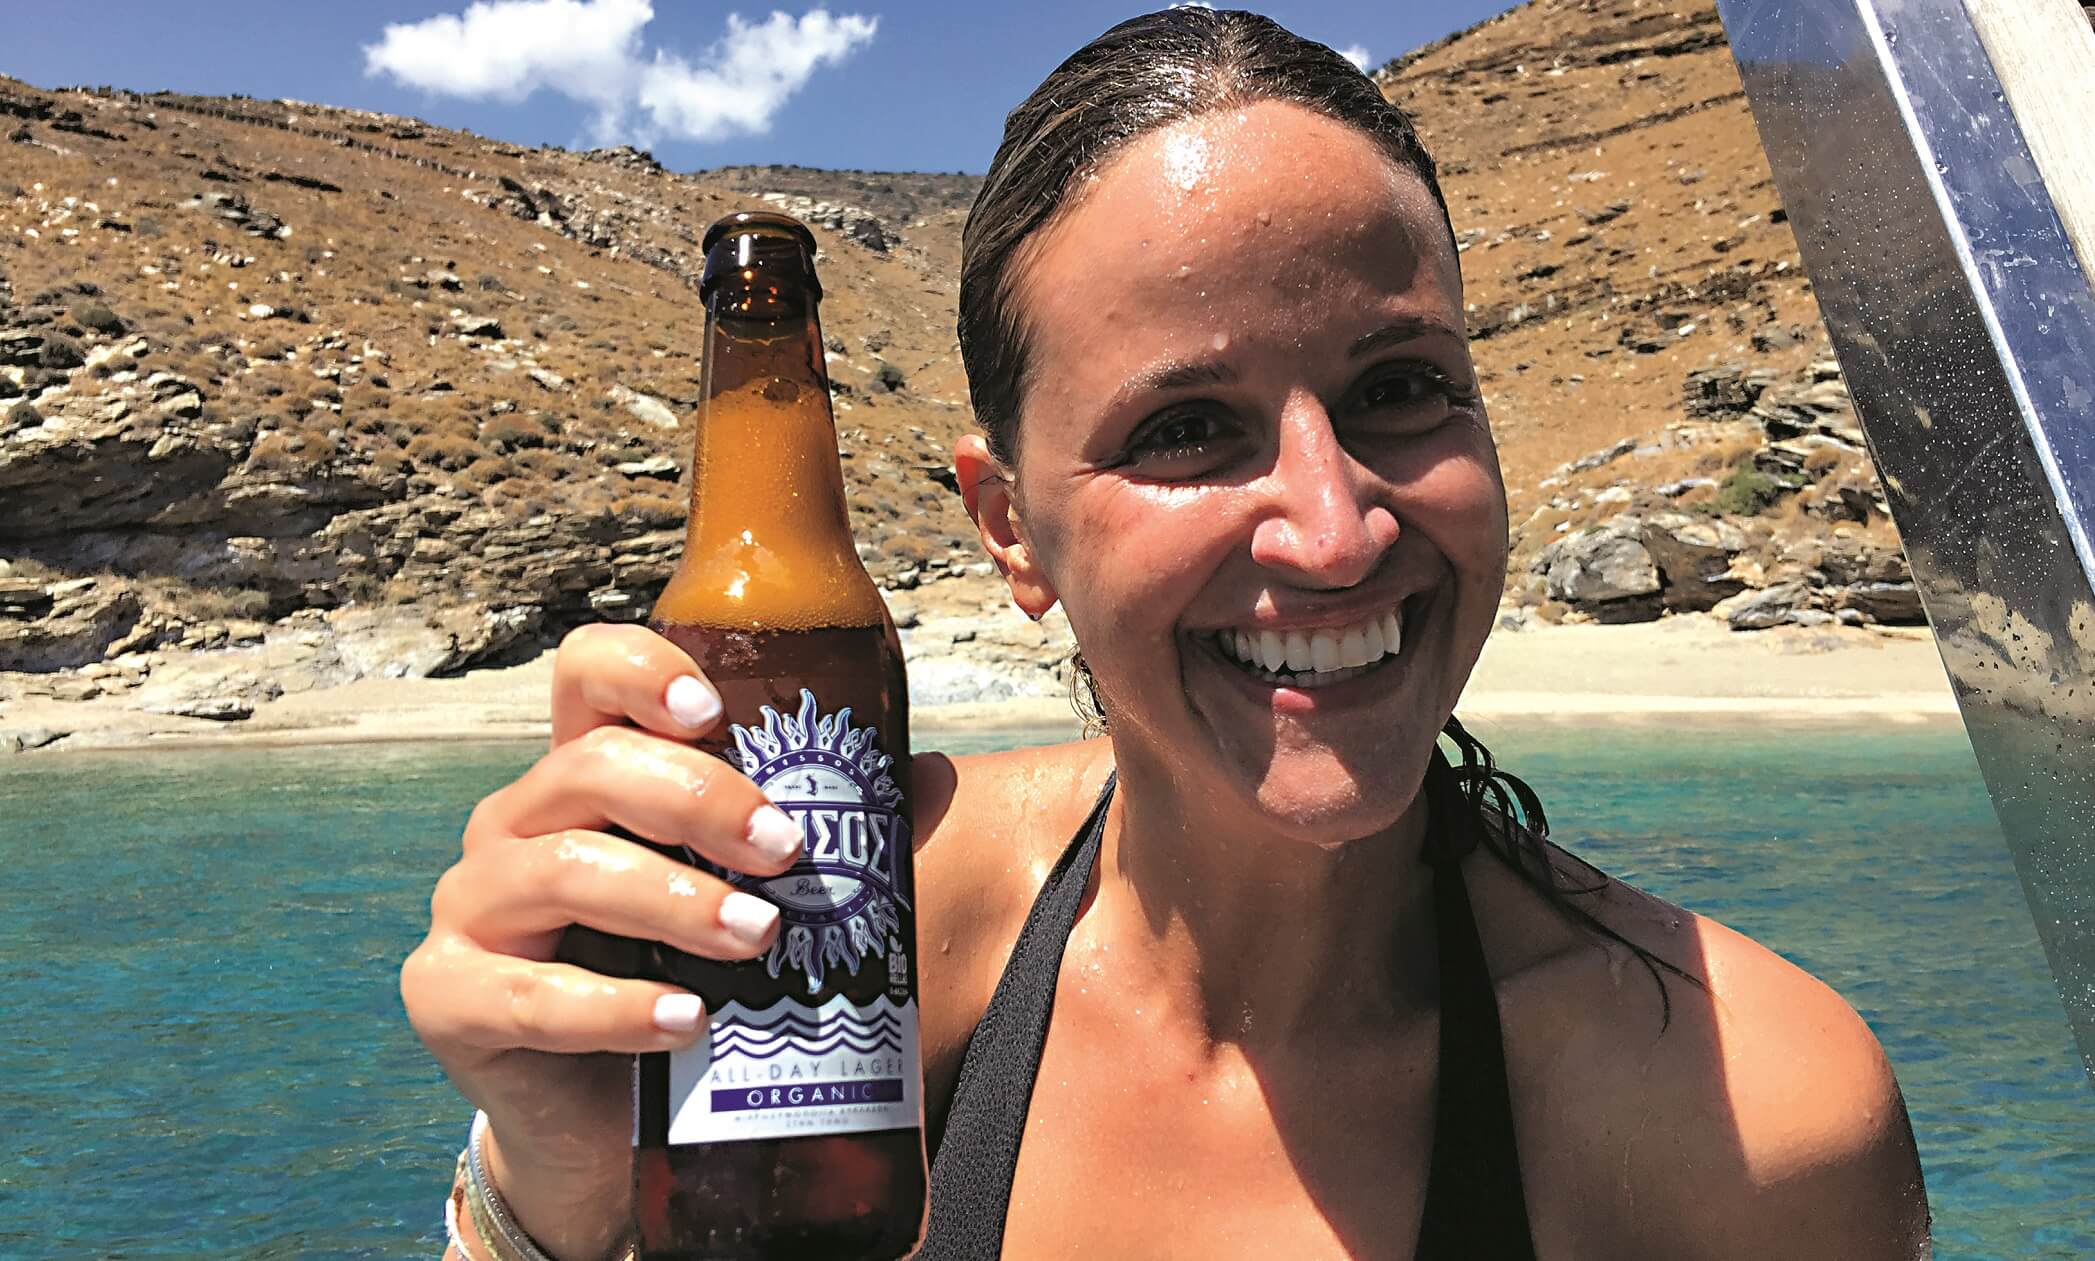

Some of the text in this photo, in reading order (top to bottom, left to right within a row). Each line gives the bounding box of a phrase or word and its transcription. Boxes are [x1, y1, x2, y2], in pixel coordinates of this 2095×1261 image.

[790, 879, 835, 896] Beer
[711, 1061, 821, 1083] ALL-DAY
[746, 1083, 873, 1107] ORGANIC
